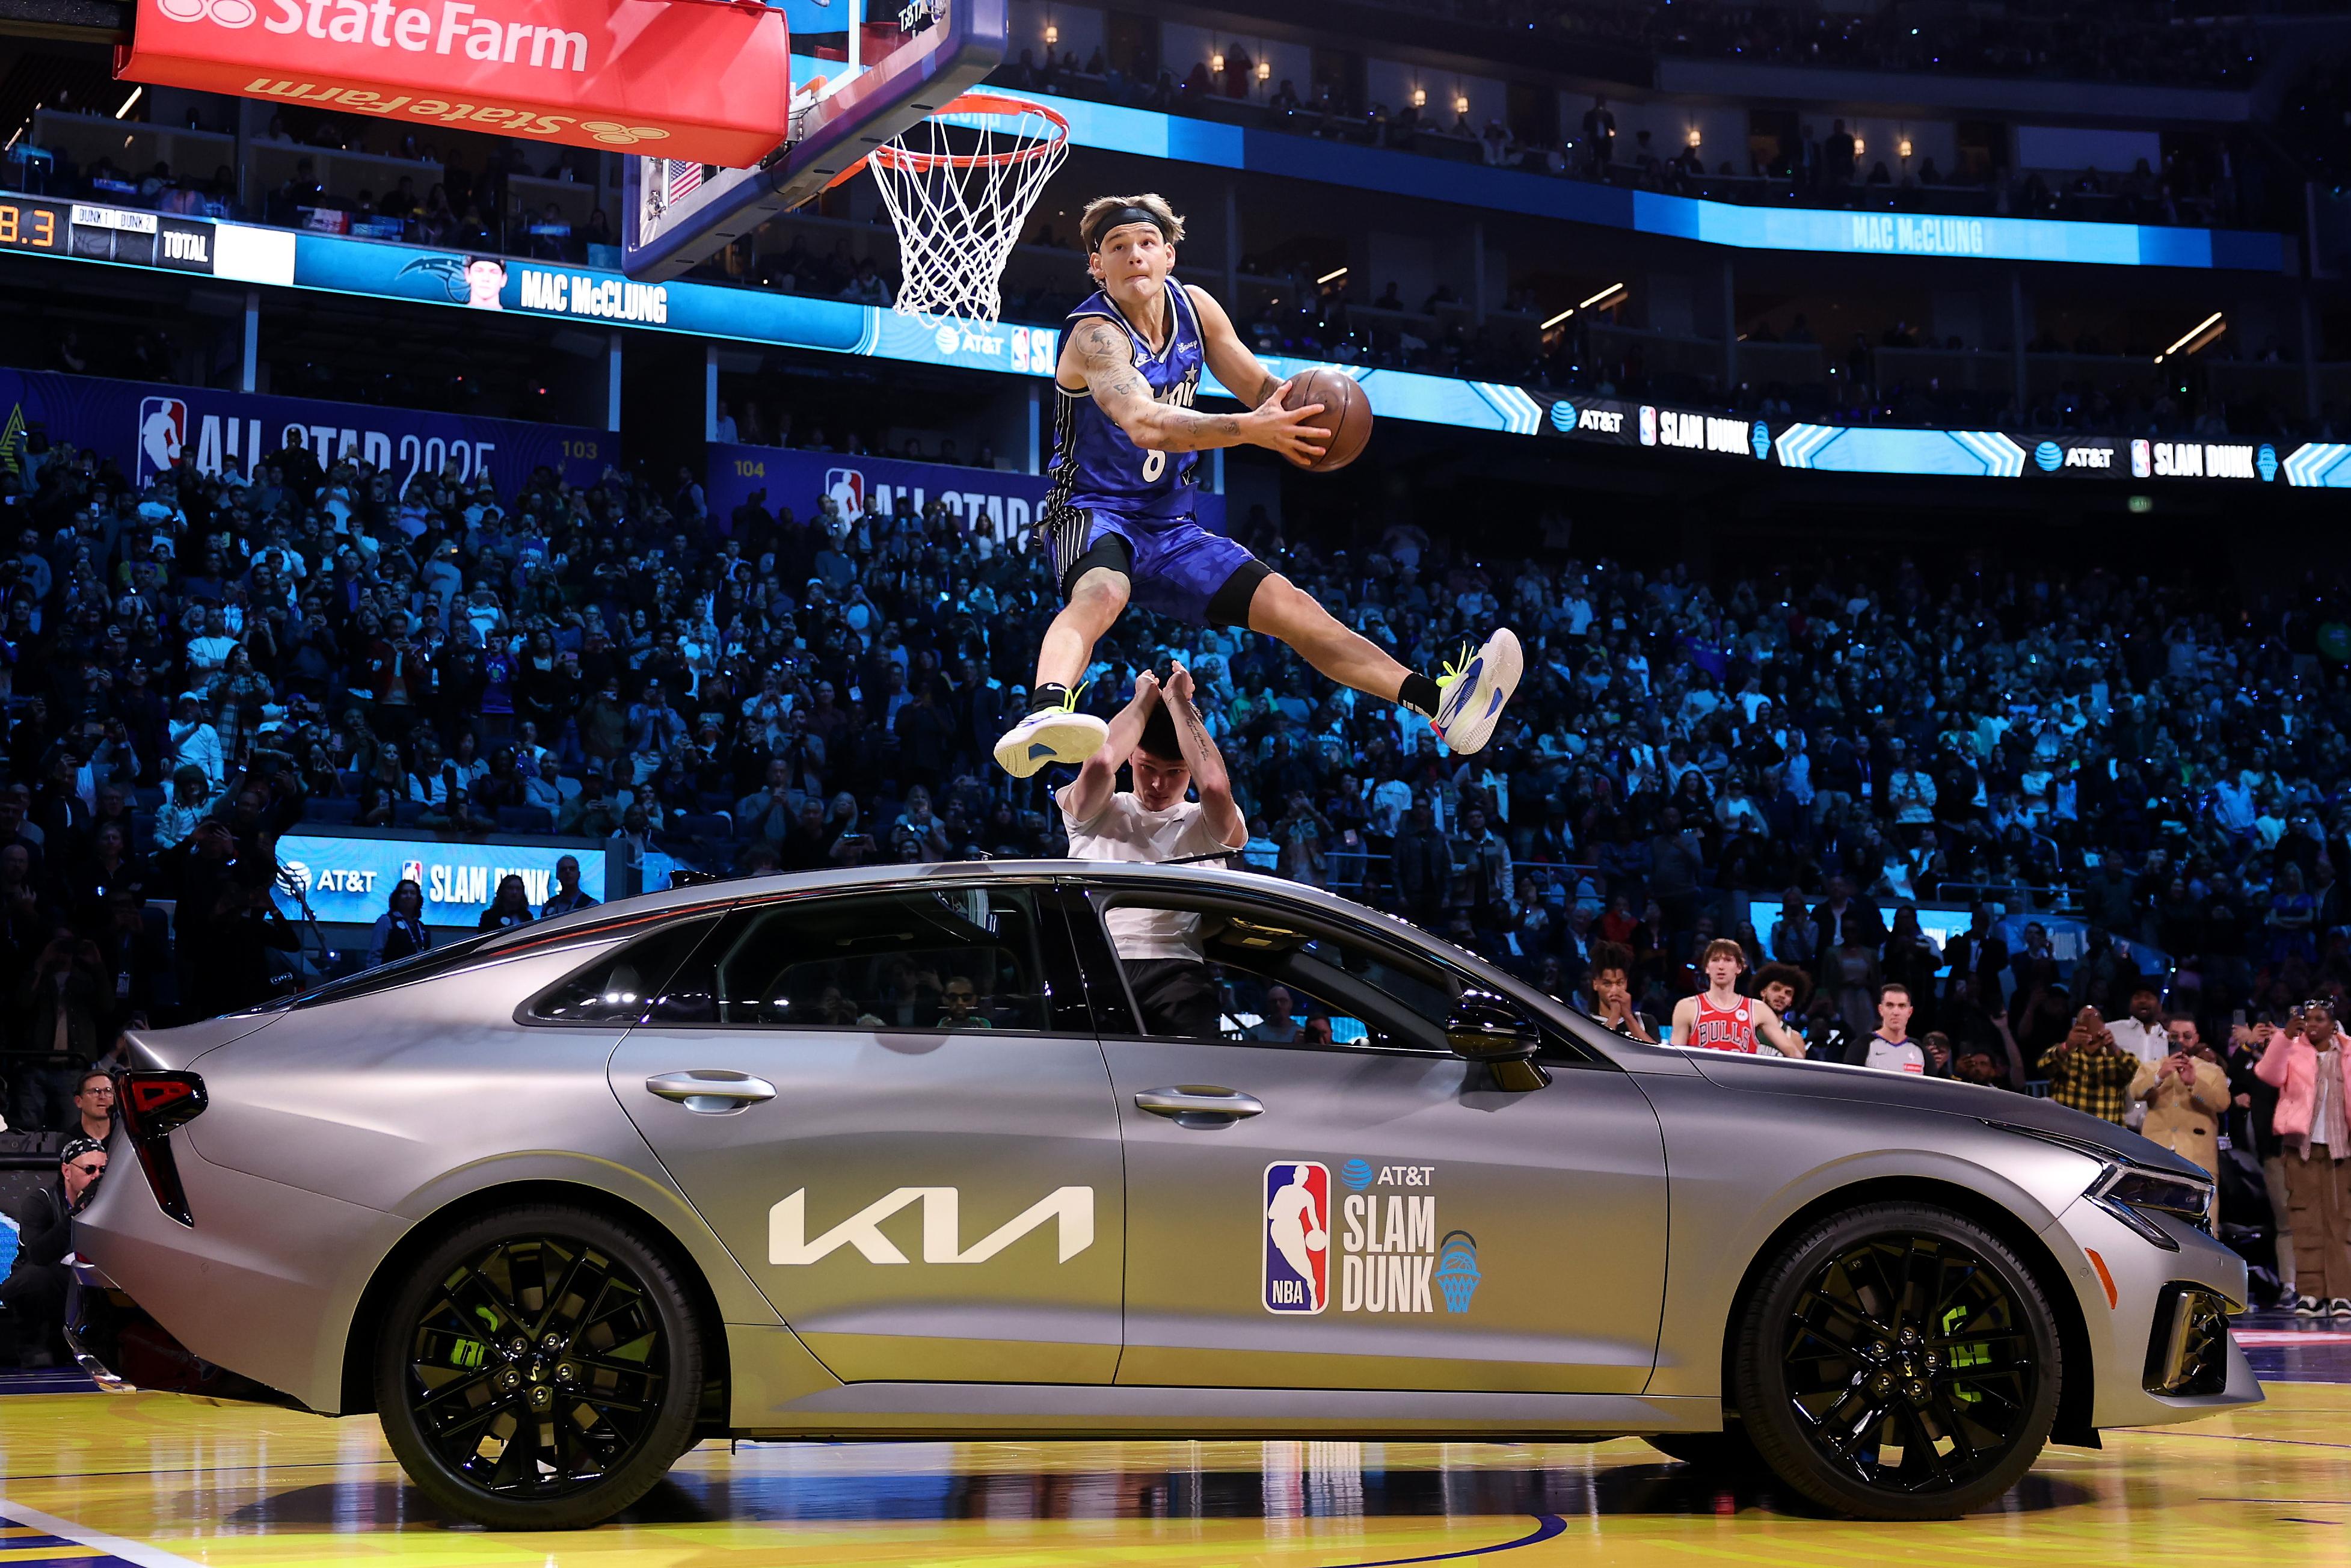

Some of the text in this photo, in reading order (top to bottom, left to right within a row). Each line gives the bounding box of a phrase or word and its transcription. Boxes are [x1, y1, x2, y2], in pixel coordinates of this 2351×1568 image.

[79, 208, 108, 225] DUNK 1
[120, 214, 150, 231] DUNK 2
[164, 231, 209, 262] TOTAL
[1853, 215, 1983, 253] MAC McCLUNG
[521, 269, 667, 324] MAC McCLUNG
[962, 334, 1004, 355] AT&T
[1031, 329, 1056, 375] SL
[1578, 409, 1623, 433] AT&T
[1659, 411, 1750, 455] SLAM DUNK
[562, 440, 597, 460] 103
[2065, 447, 2114, 468] AT&T
[2154, 443, 2255, 478] SLAM DUNK
[734, 460, 765, 478] 104
[318, 870, 377, 893] AT&T
[430, 865, 486, 904] SLAM
[1698, 1020, 1751, 1053] BULLS
[1377, 1166, 1435, 1185] AT&T
[768, 1186, 1095, 1265] KIA
[1343, 1194, 1435, 1253] SLAM
[1273, 1280, 1303, 1304] NBA
[1342, 1255, 1434, 1312] DUNK
